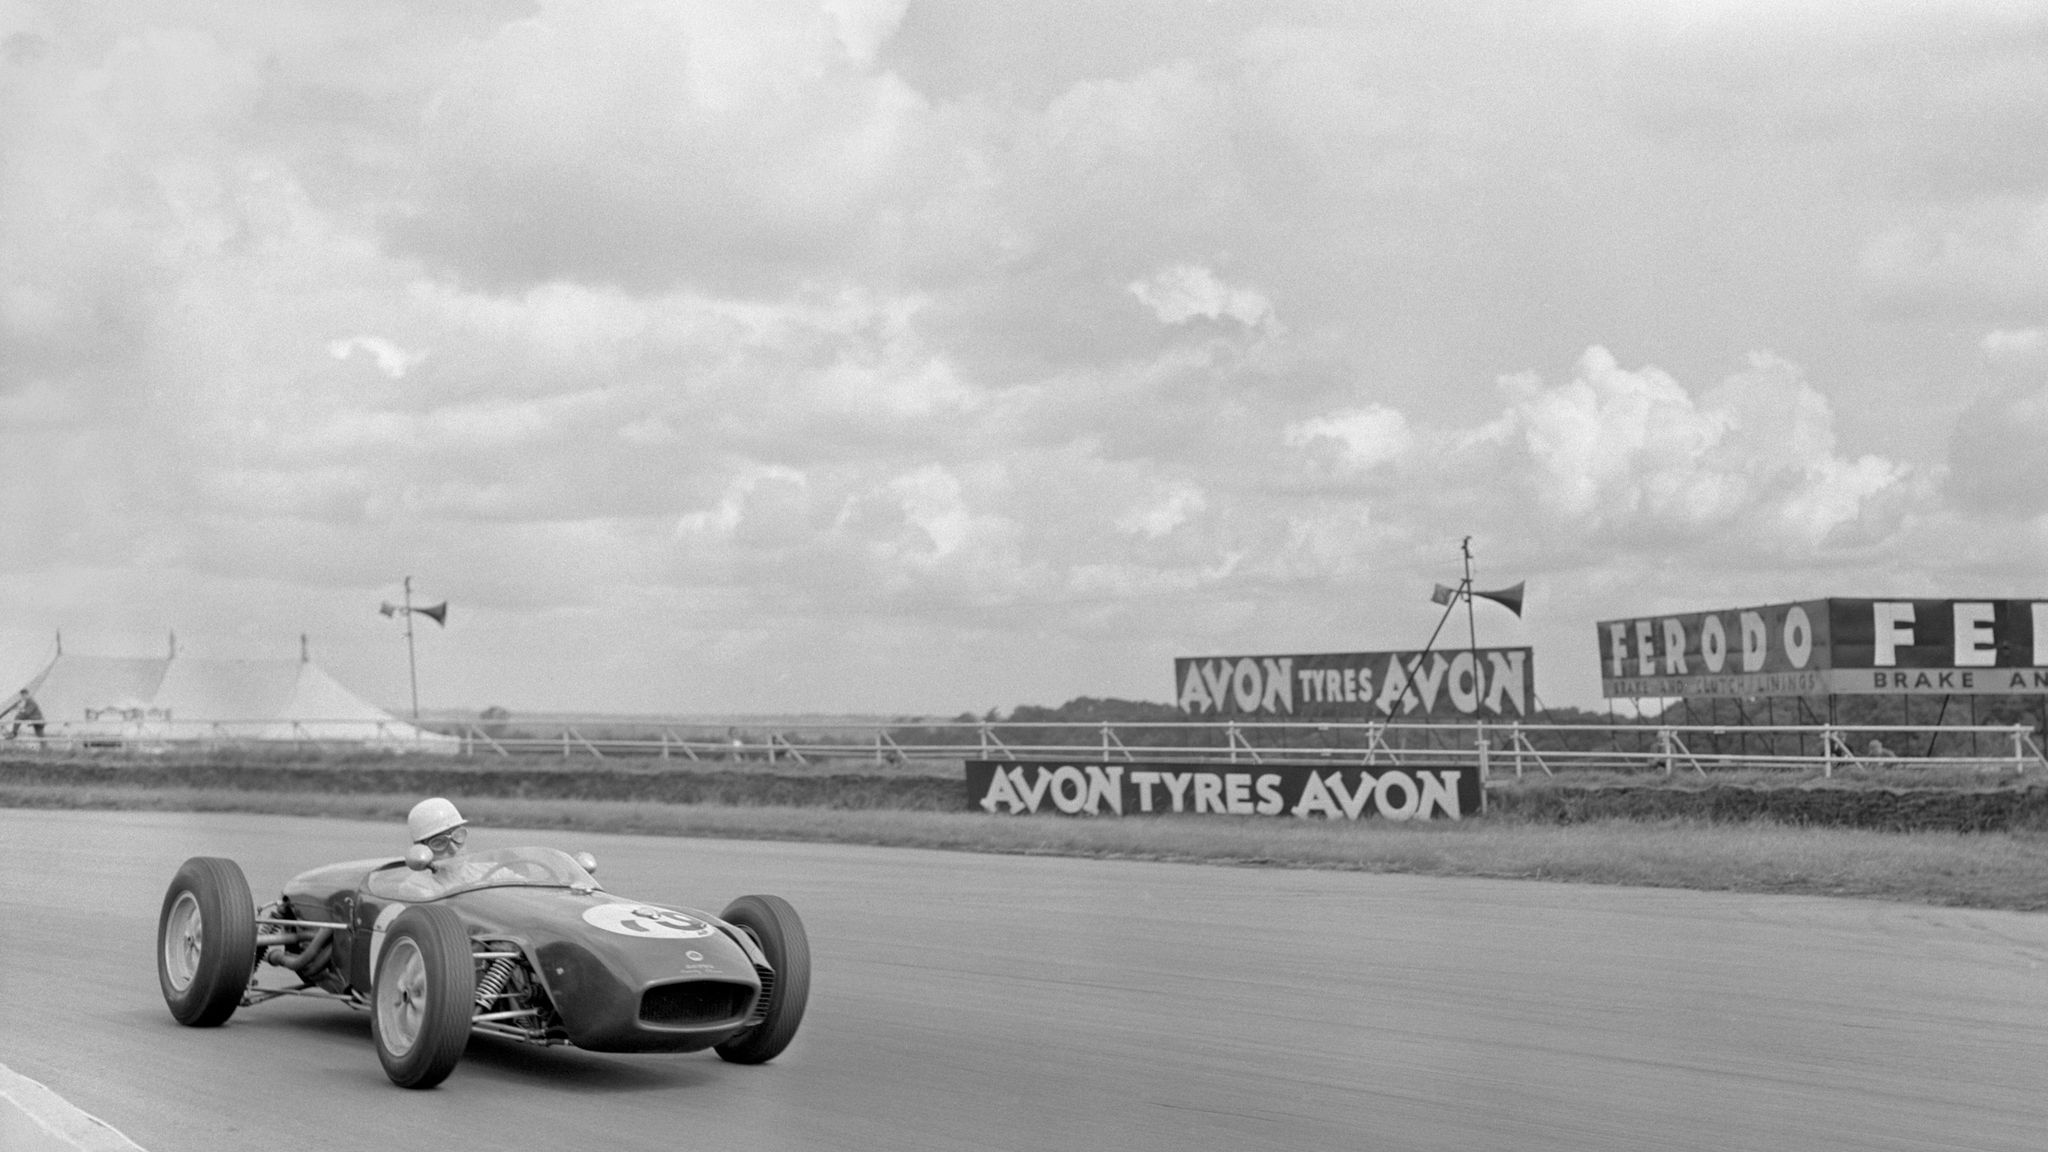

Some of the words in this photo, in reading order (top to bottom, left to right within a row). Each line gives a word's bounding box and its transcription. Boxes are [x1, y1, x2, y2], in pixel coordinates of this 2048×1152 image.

[1610, 606, 1812, 676] FERODO
[1179, 658, 1293, 715] AVON
[1298, 668, 1373, 703] TYRES
[1375, 651, 1525, 716] AVON
[1874, 672, 1974, 688] BRAKE
[980, 765, 1123, 816] AVON
[1131, 771, 1282, 815] TYRES
[1291, 770, 1461, 820] AVON
